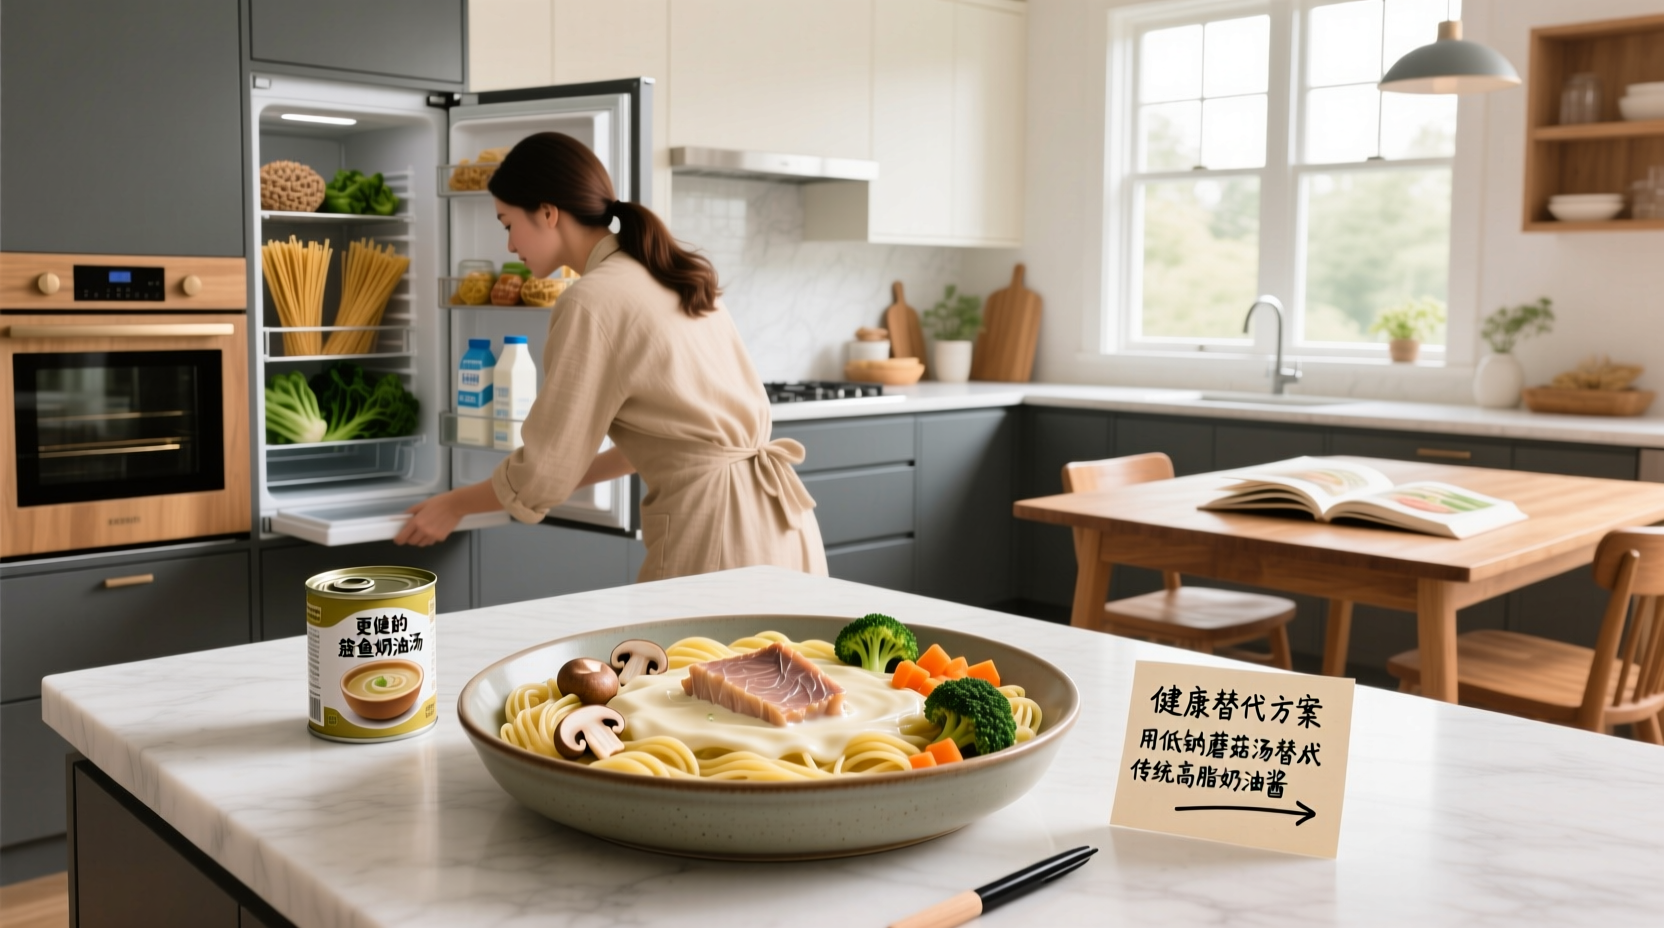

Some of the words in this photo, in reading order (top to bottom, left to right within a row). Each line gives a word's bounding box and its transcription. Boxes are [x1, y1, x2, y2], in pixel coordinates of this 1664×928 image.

[1150, 684, 1323, 729] 健康替代方案
[1140, 728, 1322, 767] 用低钠蘑菇汤替代
[1130, 758, 1289, 799] 传统高脂奶油酱
